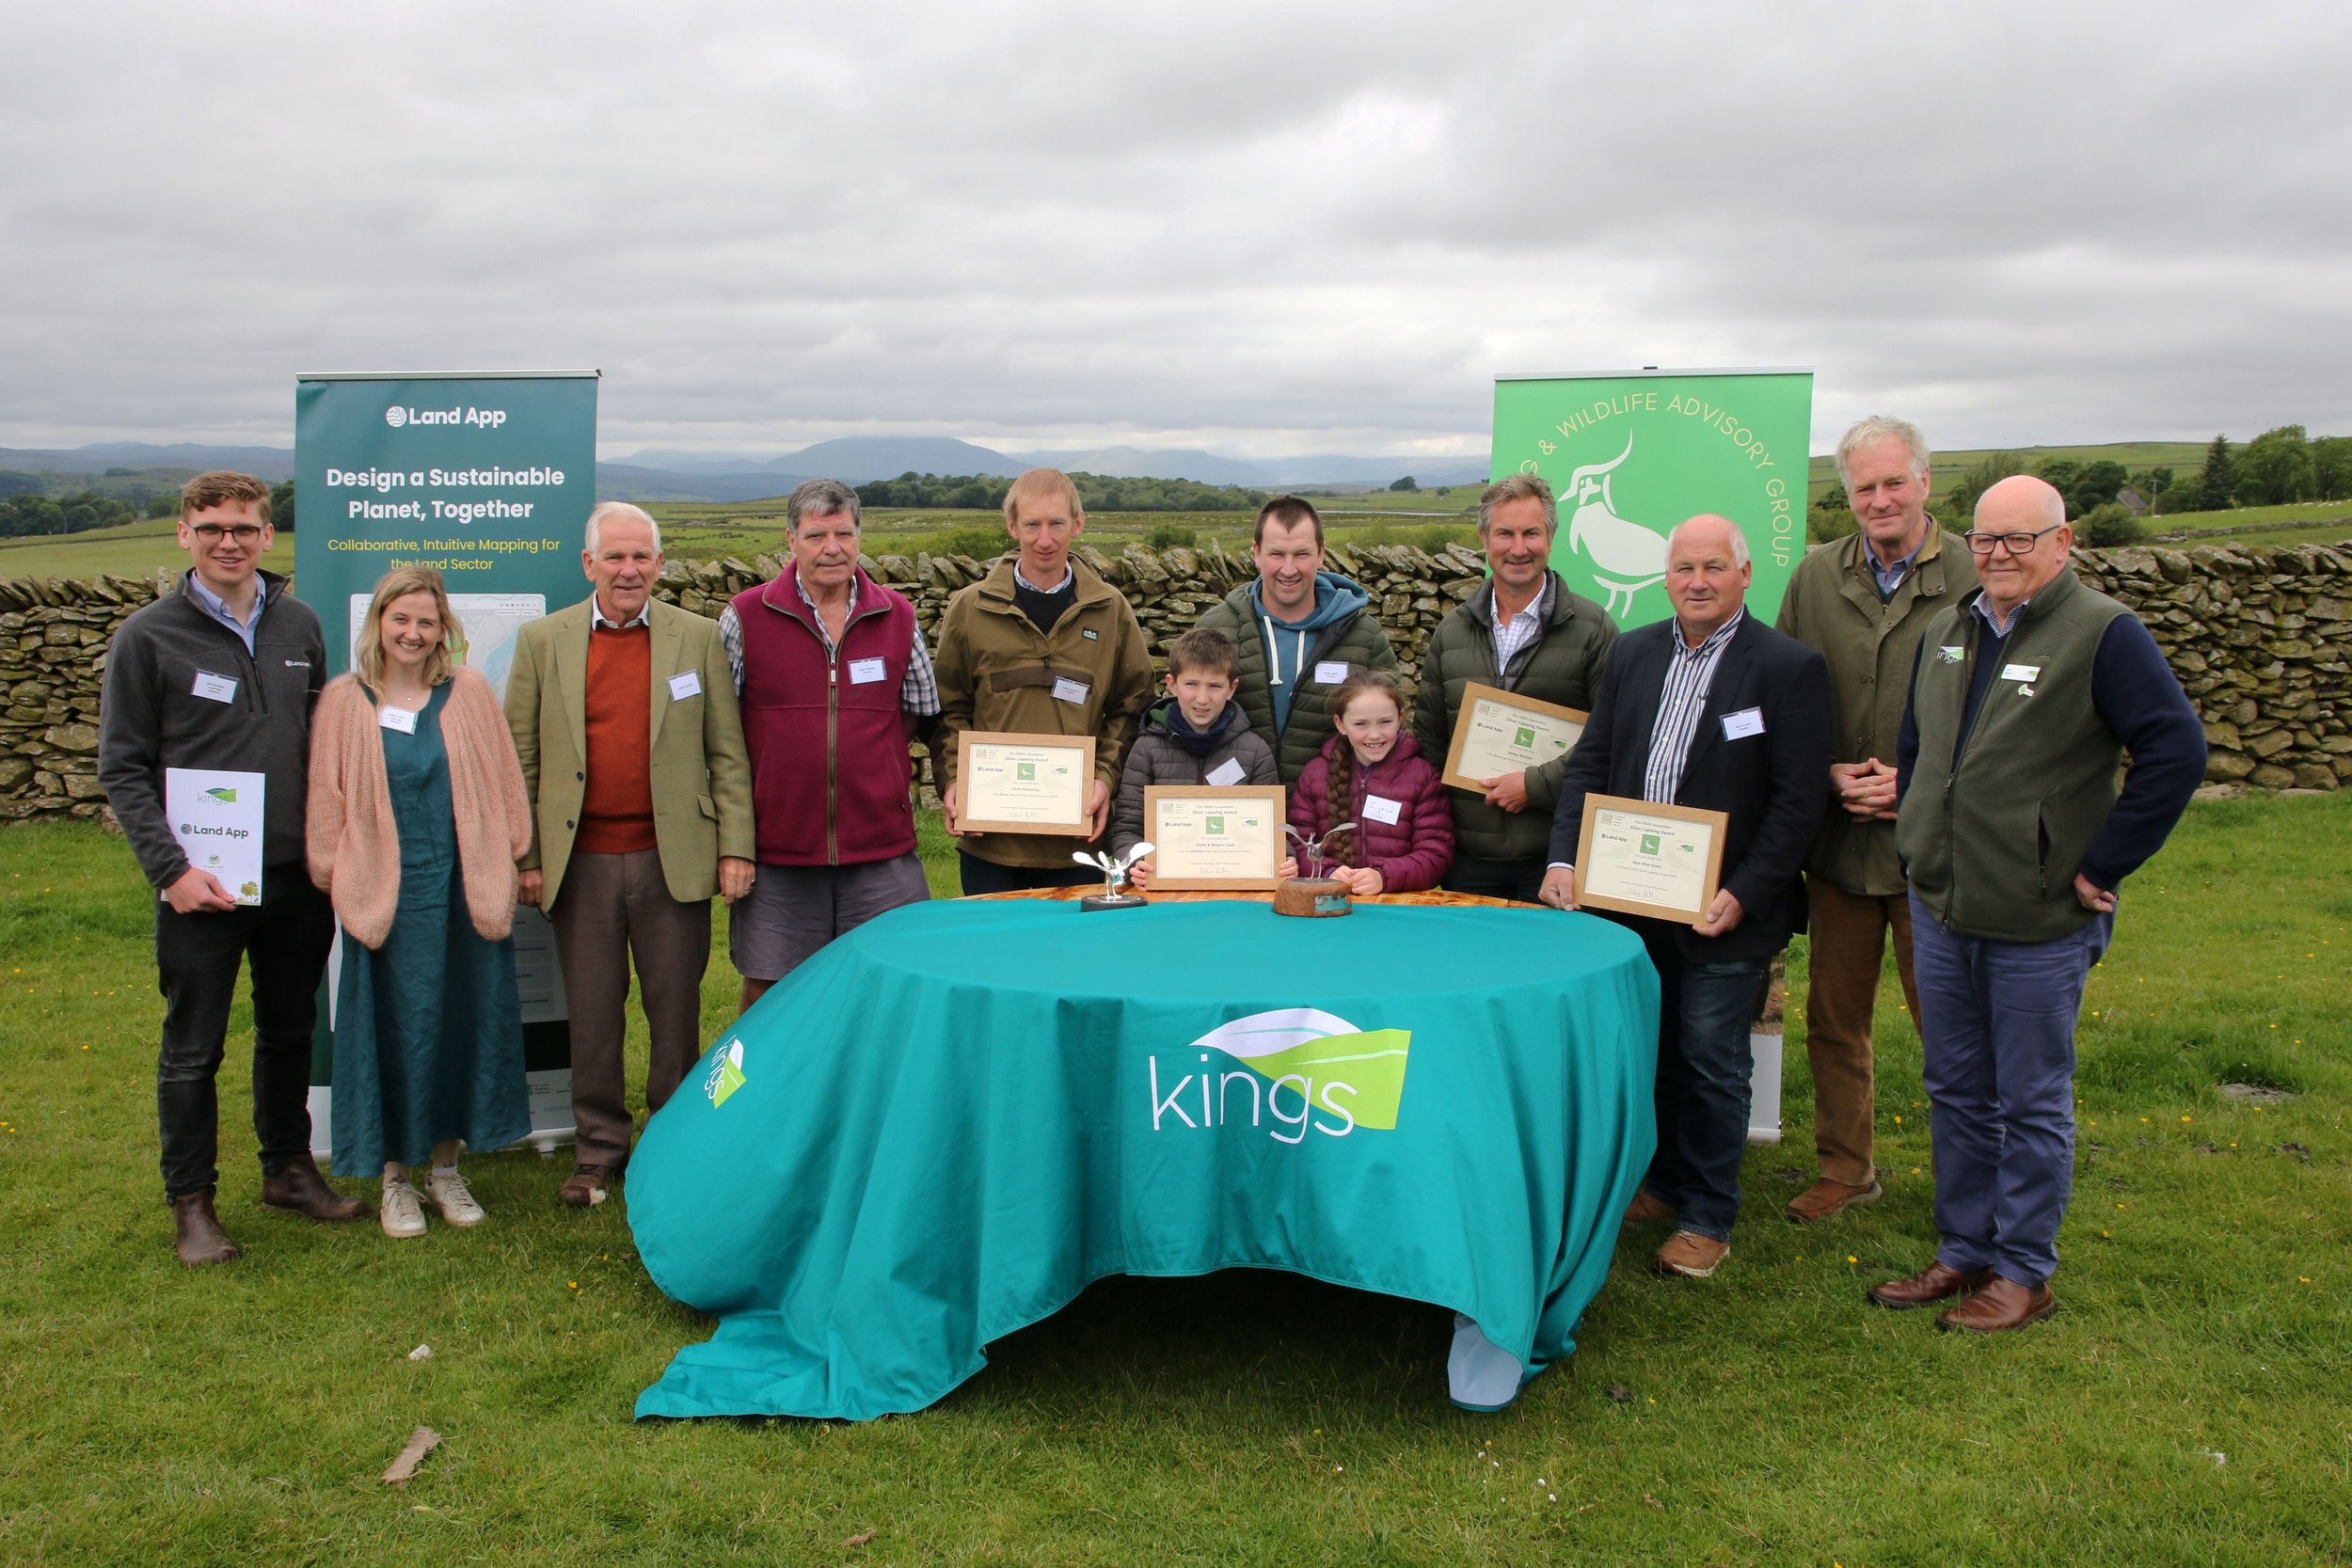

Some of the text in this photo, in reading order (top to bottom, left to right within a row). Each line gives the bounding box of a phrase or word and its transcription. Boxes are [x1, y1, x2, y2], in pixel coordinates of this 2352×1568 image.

[409, 407, 506, 428] Land App
[326, 467, 564, 493] Design a Sustainable
[1538, 439, 1557, 455] &
[1556, 392, 1658, 438] WILDLIFE
[1667, 393, 1775, 469] ADVISORY
[1766, 478, 1792, 567] GROUP
[349, 500, 533, 524] Planet, Together
[328, 539, 561, 554] Collaborative, Intuitive Mapping for
[391, 558, 412, 570] the
[451, 558, 494, 570] Sector
[197, 792, 230, 806] kings
[194, 825, 249, 839] Land App
[1149, 1053, 1358, 1145] kings
